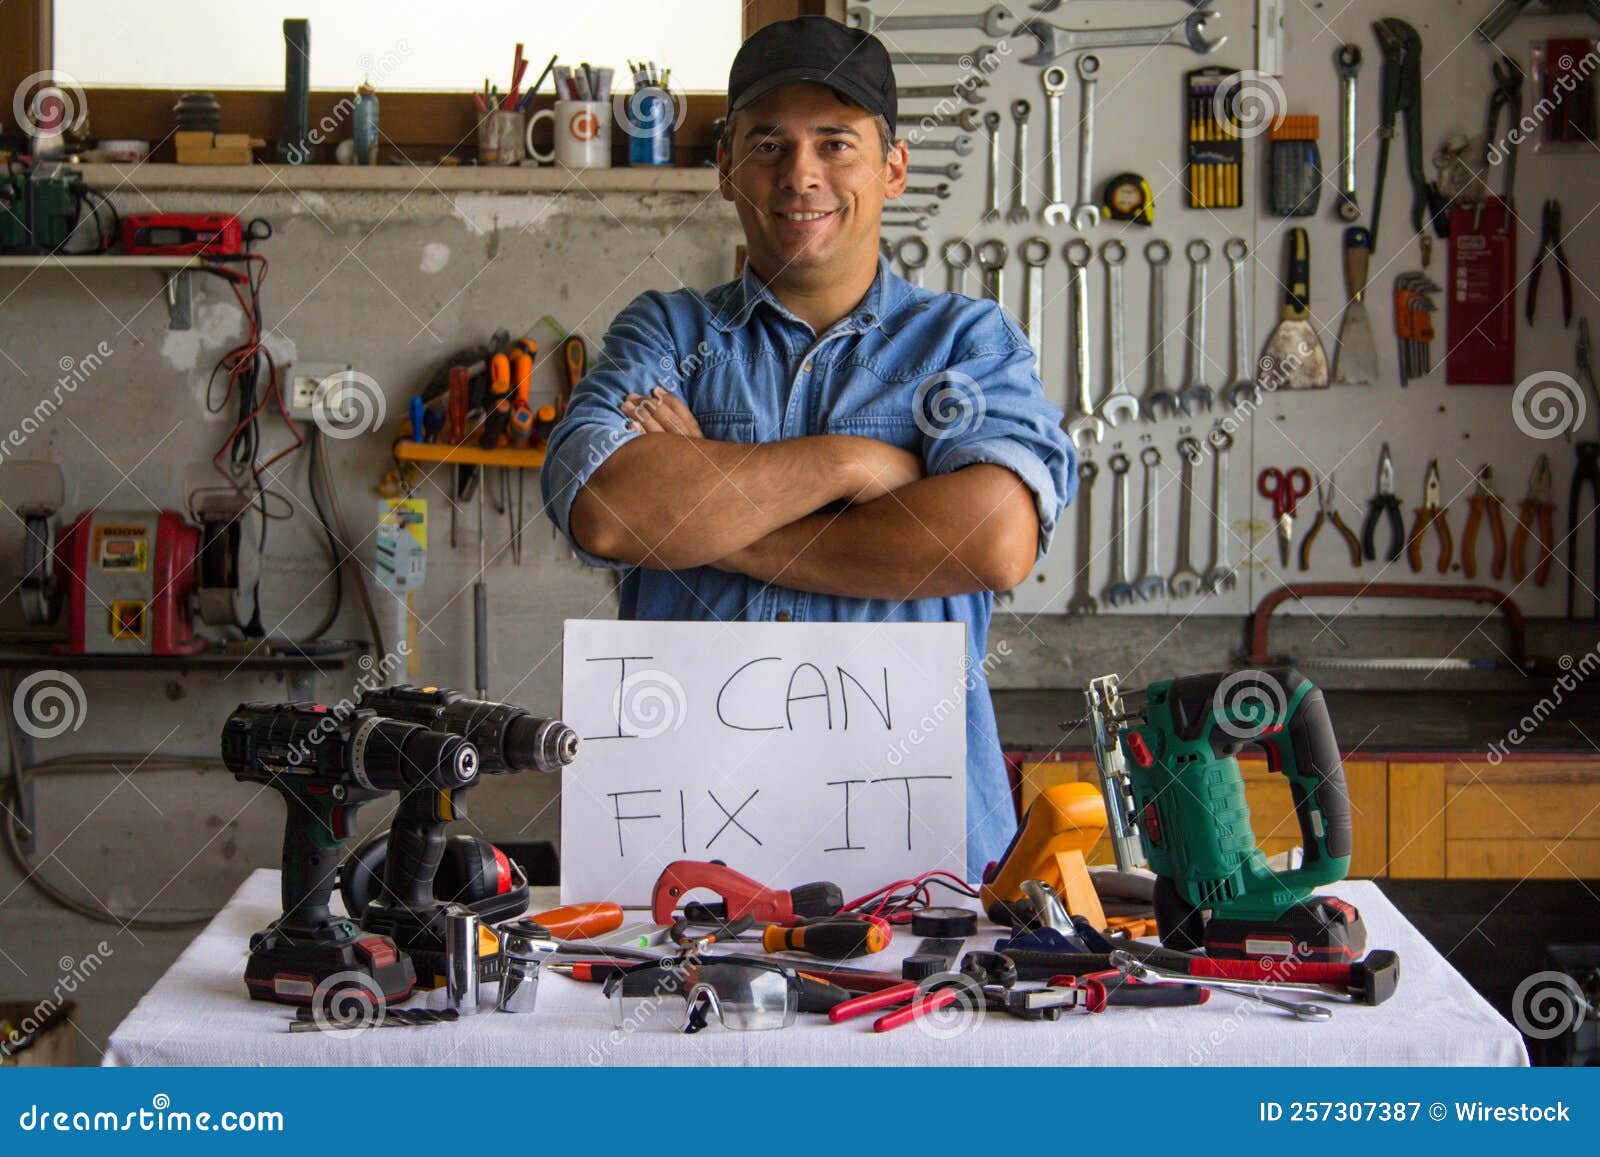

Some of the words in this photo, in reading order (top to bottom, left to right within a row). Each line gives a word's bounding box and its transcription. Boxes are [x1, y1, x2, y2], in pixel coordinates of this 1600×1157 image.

[583, 656, 653, 741] I
[716, 656, 892, 731] CAN
[607, 789, 762, 857] FIX
[824, 775, 953, 852] IT
